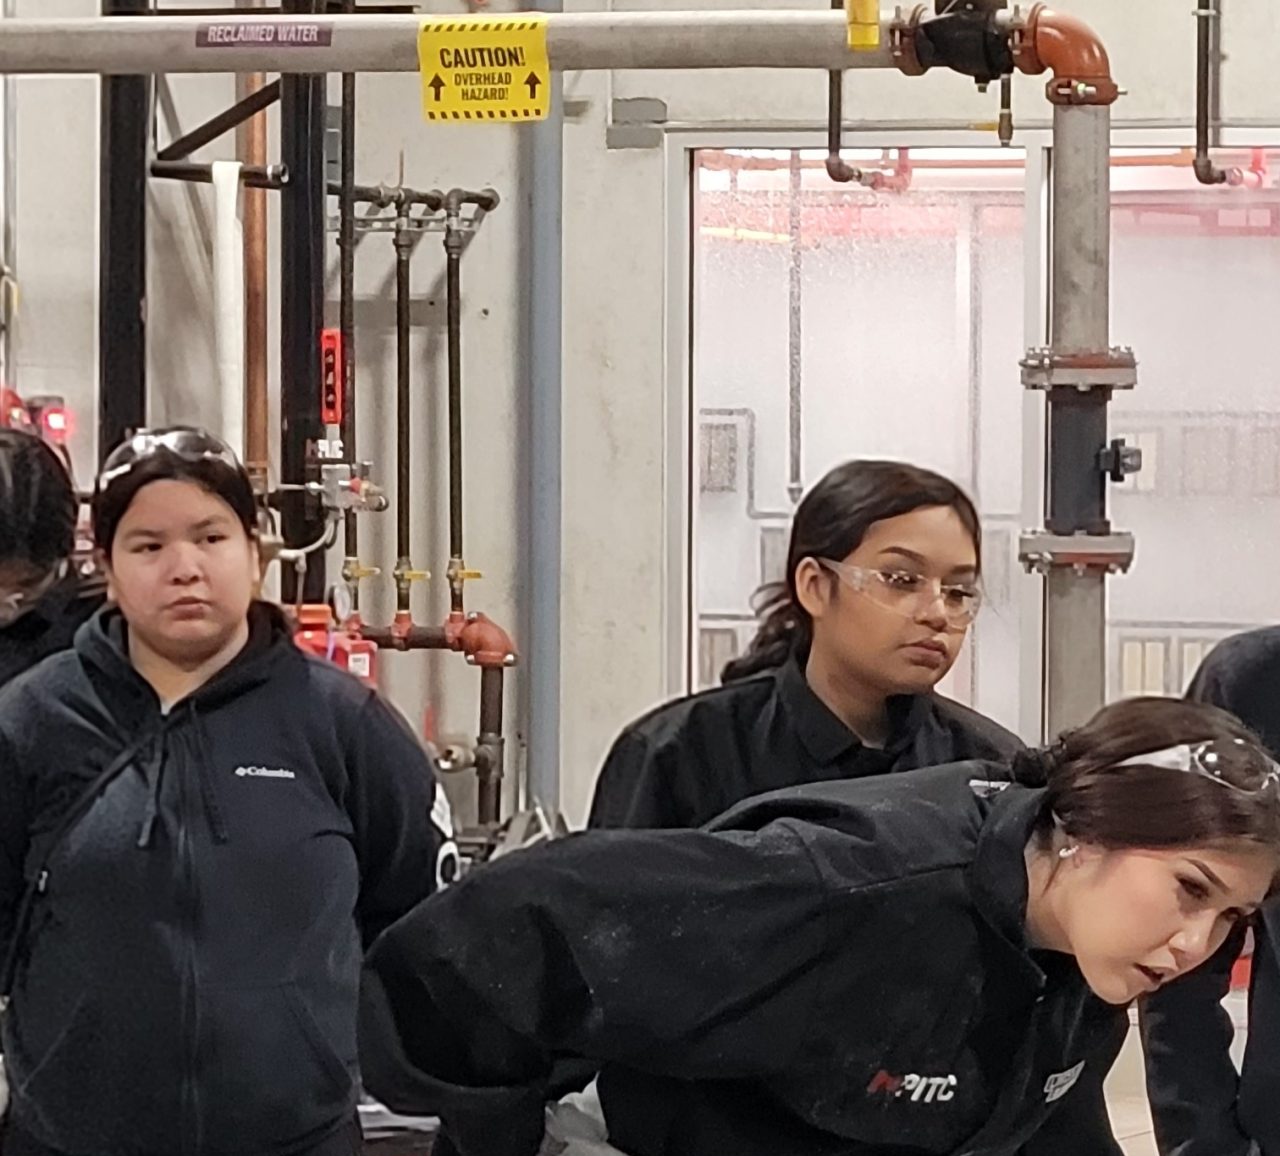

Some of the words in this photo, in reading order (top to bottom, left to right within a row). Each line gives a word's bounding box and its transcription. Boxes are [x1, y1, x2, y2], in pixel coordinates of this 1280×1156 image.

[207, 25, 275, 42] RECLAIMED
[277, 24, 318, 42] WATER
[439, 46, 526, 68] CAUTION!
[454, 72, 512, 86] OVERHEAD
[461, 87, 509, 101] HAZARD!
